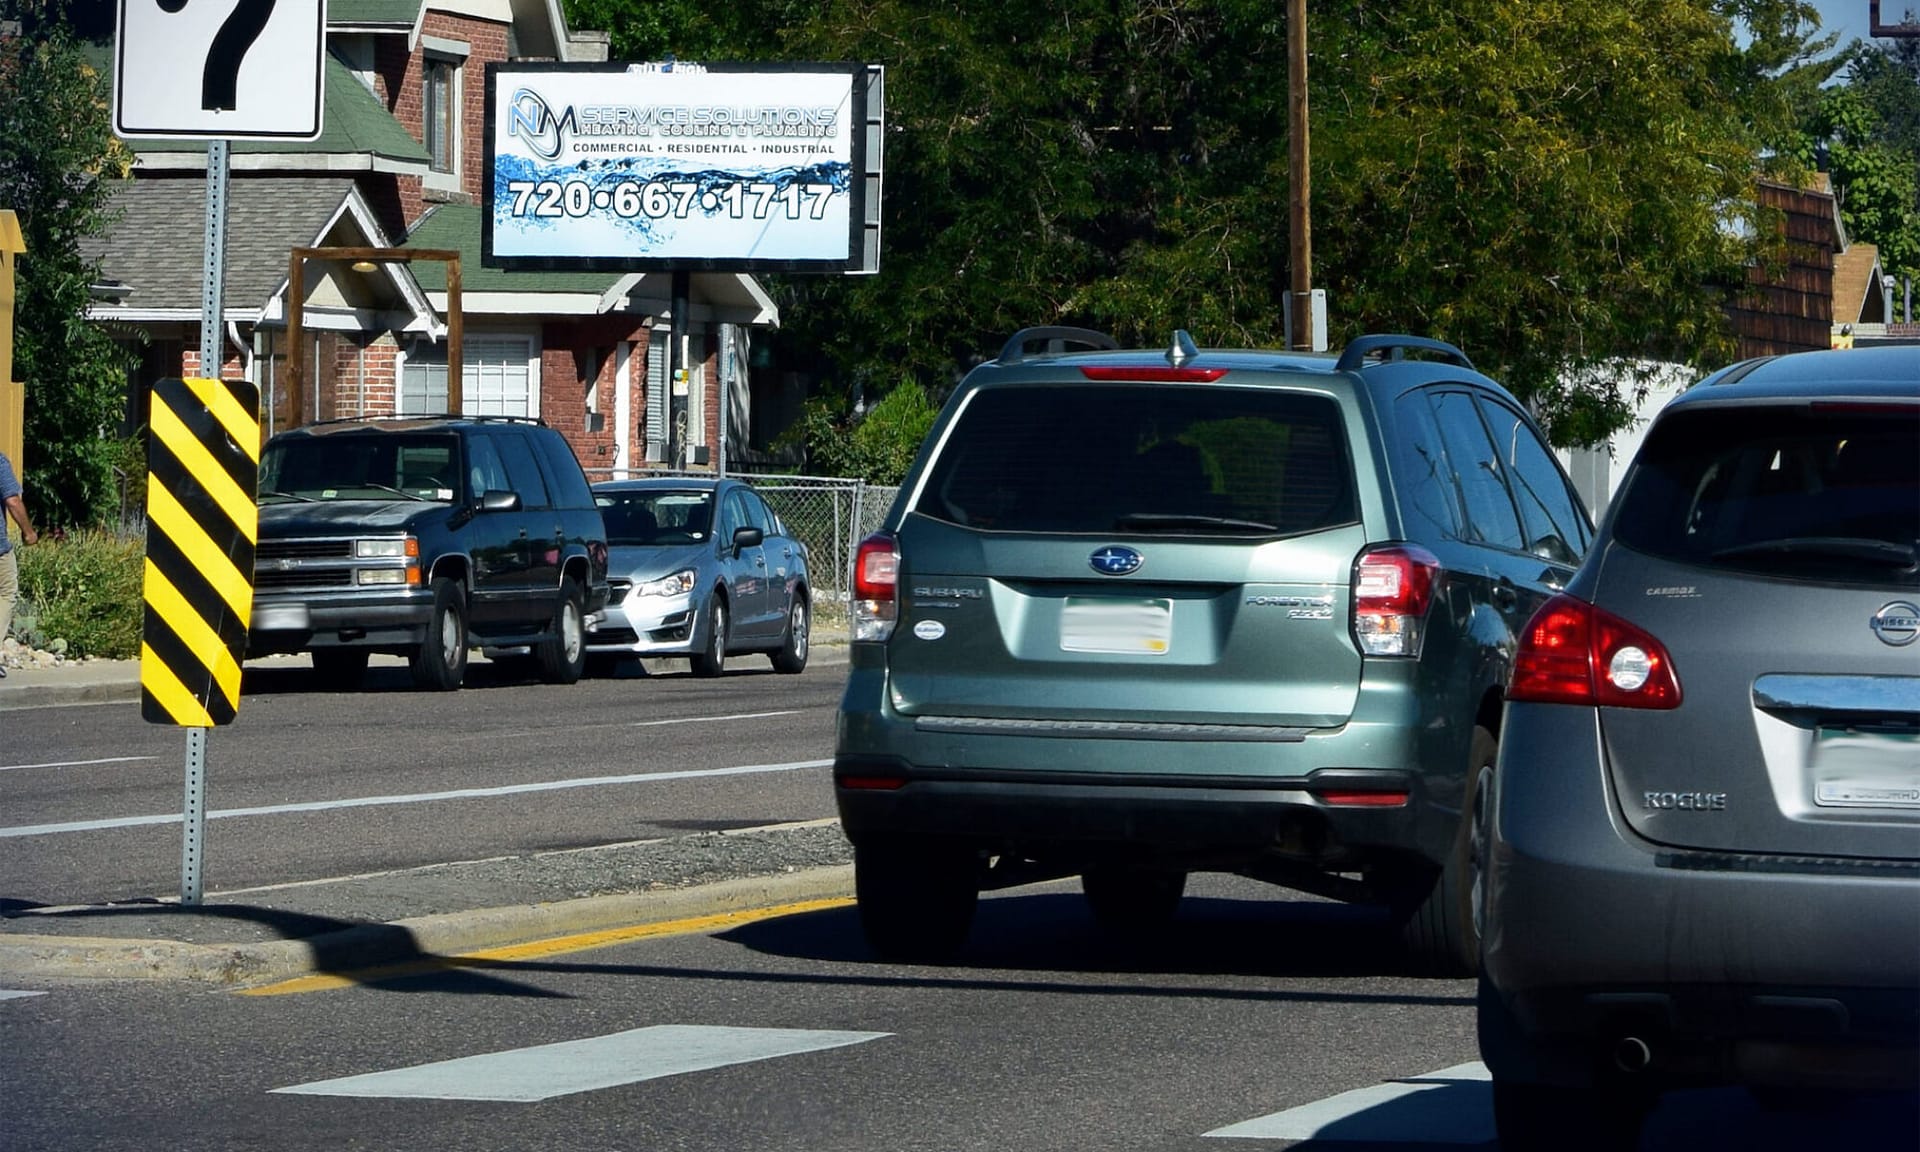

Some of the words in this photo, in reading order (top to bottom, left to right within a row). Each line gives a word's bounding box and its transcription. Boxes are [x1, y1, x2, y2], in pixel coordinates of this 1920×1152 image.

[581, 105, 689, 125] SERVICE
[693, 105, 838, 126] SOLUTIONS
[659, 124, 732, 137] COOLING
[752, 125, 838, 138] PLUMBING
[573, 143, 654, 153] COMMERCIAL
[667, 143, 748, 154] RESIDENTIAL
[761, 144, 835, 154] INDUSTRIAL
[912, 586, 984, 600] SUBARU
[1641, 791, 1728, 811] ROGUE
